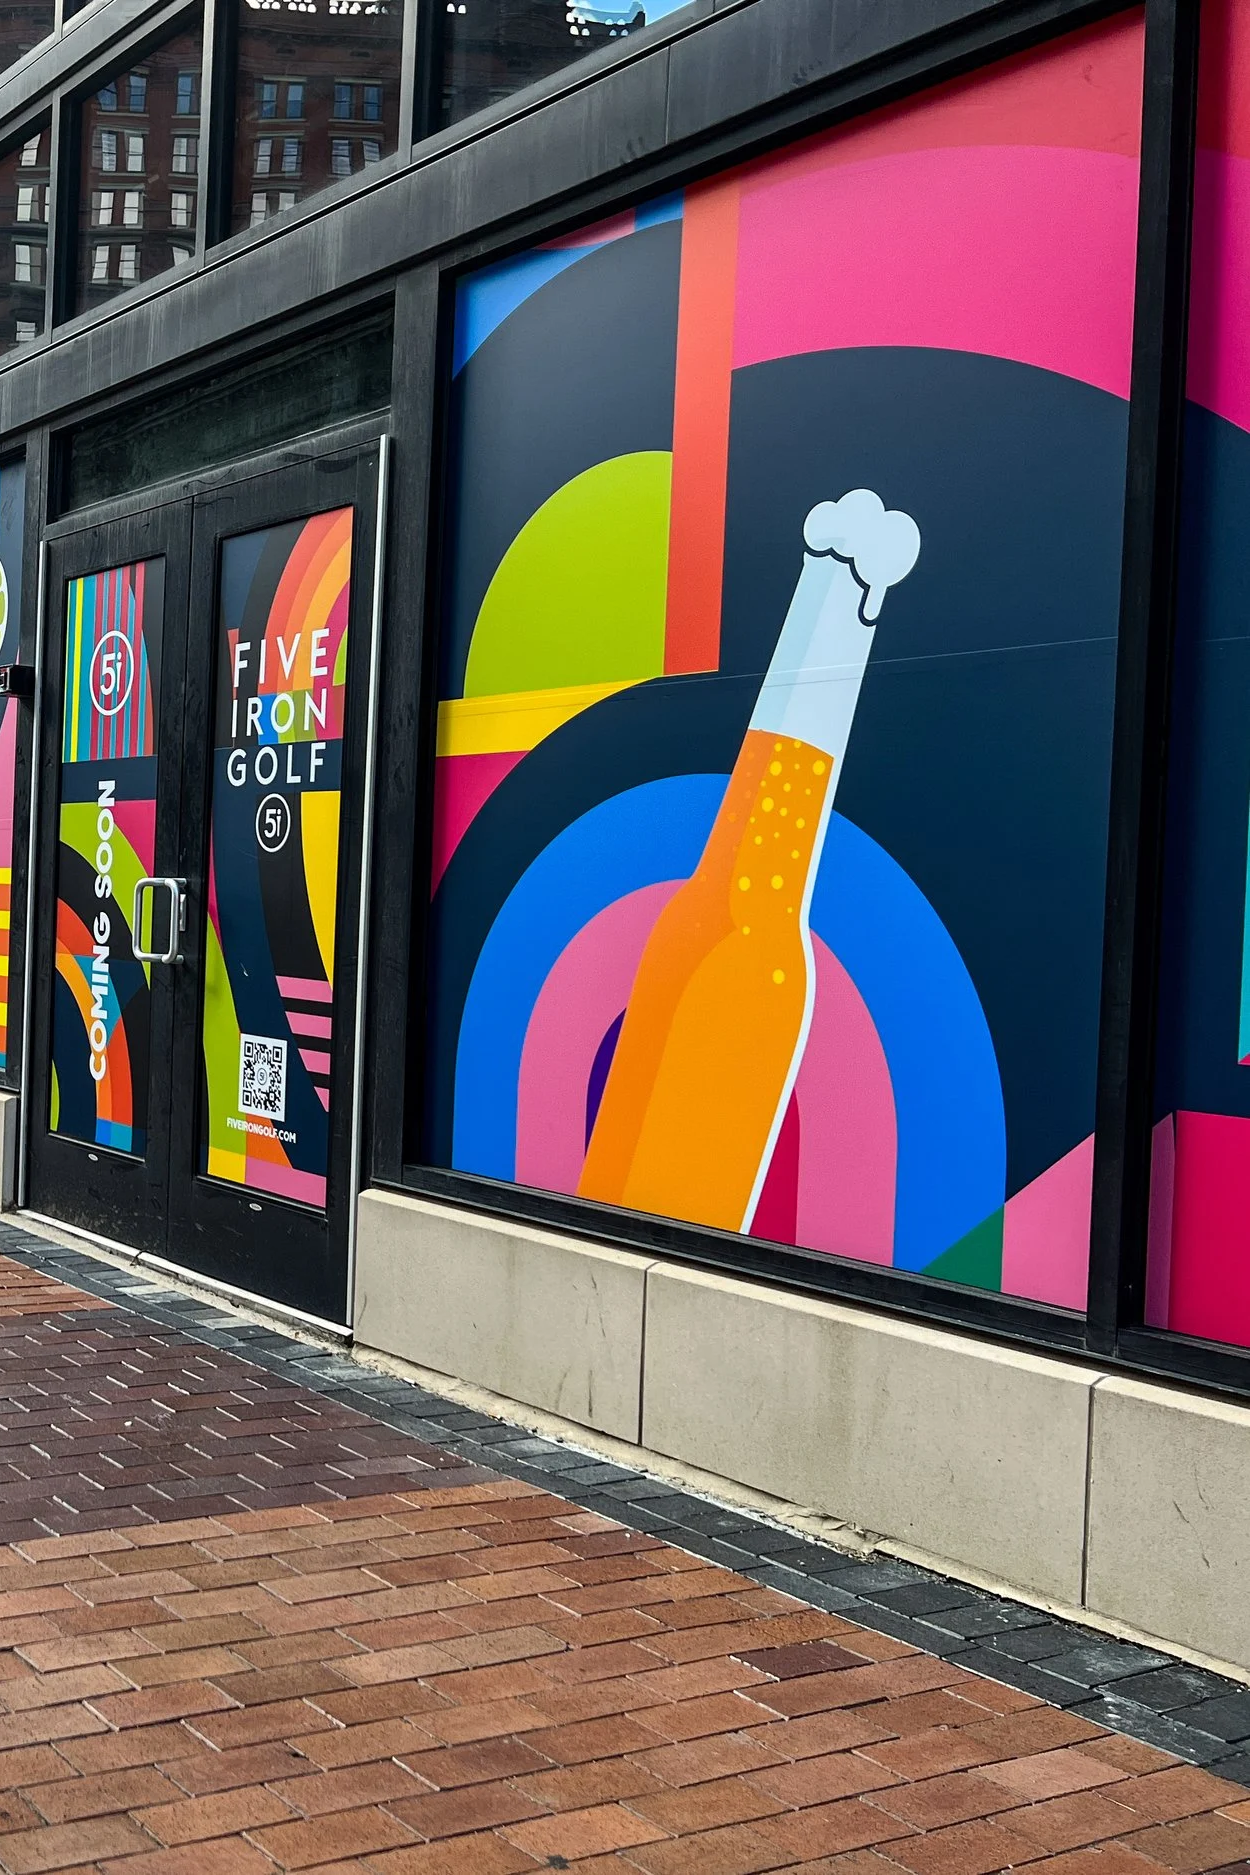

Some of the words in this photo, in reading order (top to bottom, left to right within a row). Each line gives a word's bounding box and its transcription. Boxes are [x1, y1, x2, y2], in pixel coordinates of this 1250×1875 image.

[100, 651, 122, 696] 5i
[233, 628, 329, 688] FIVE
[231, 687, 327, 738] IRON
[227, 742, 326, 787] GOLF
[94, 780, 116, 899] SOON
[263, 808, 282, 838] 5i
[88, 911, 111, 1081] COMING
[226, 1117, 297, 1144] FIVEIRONGOLF.COM
